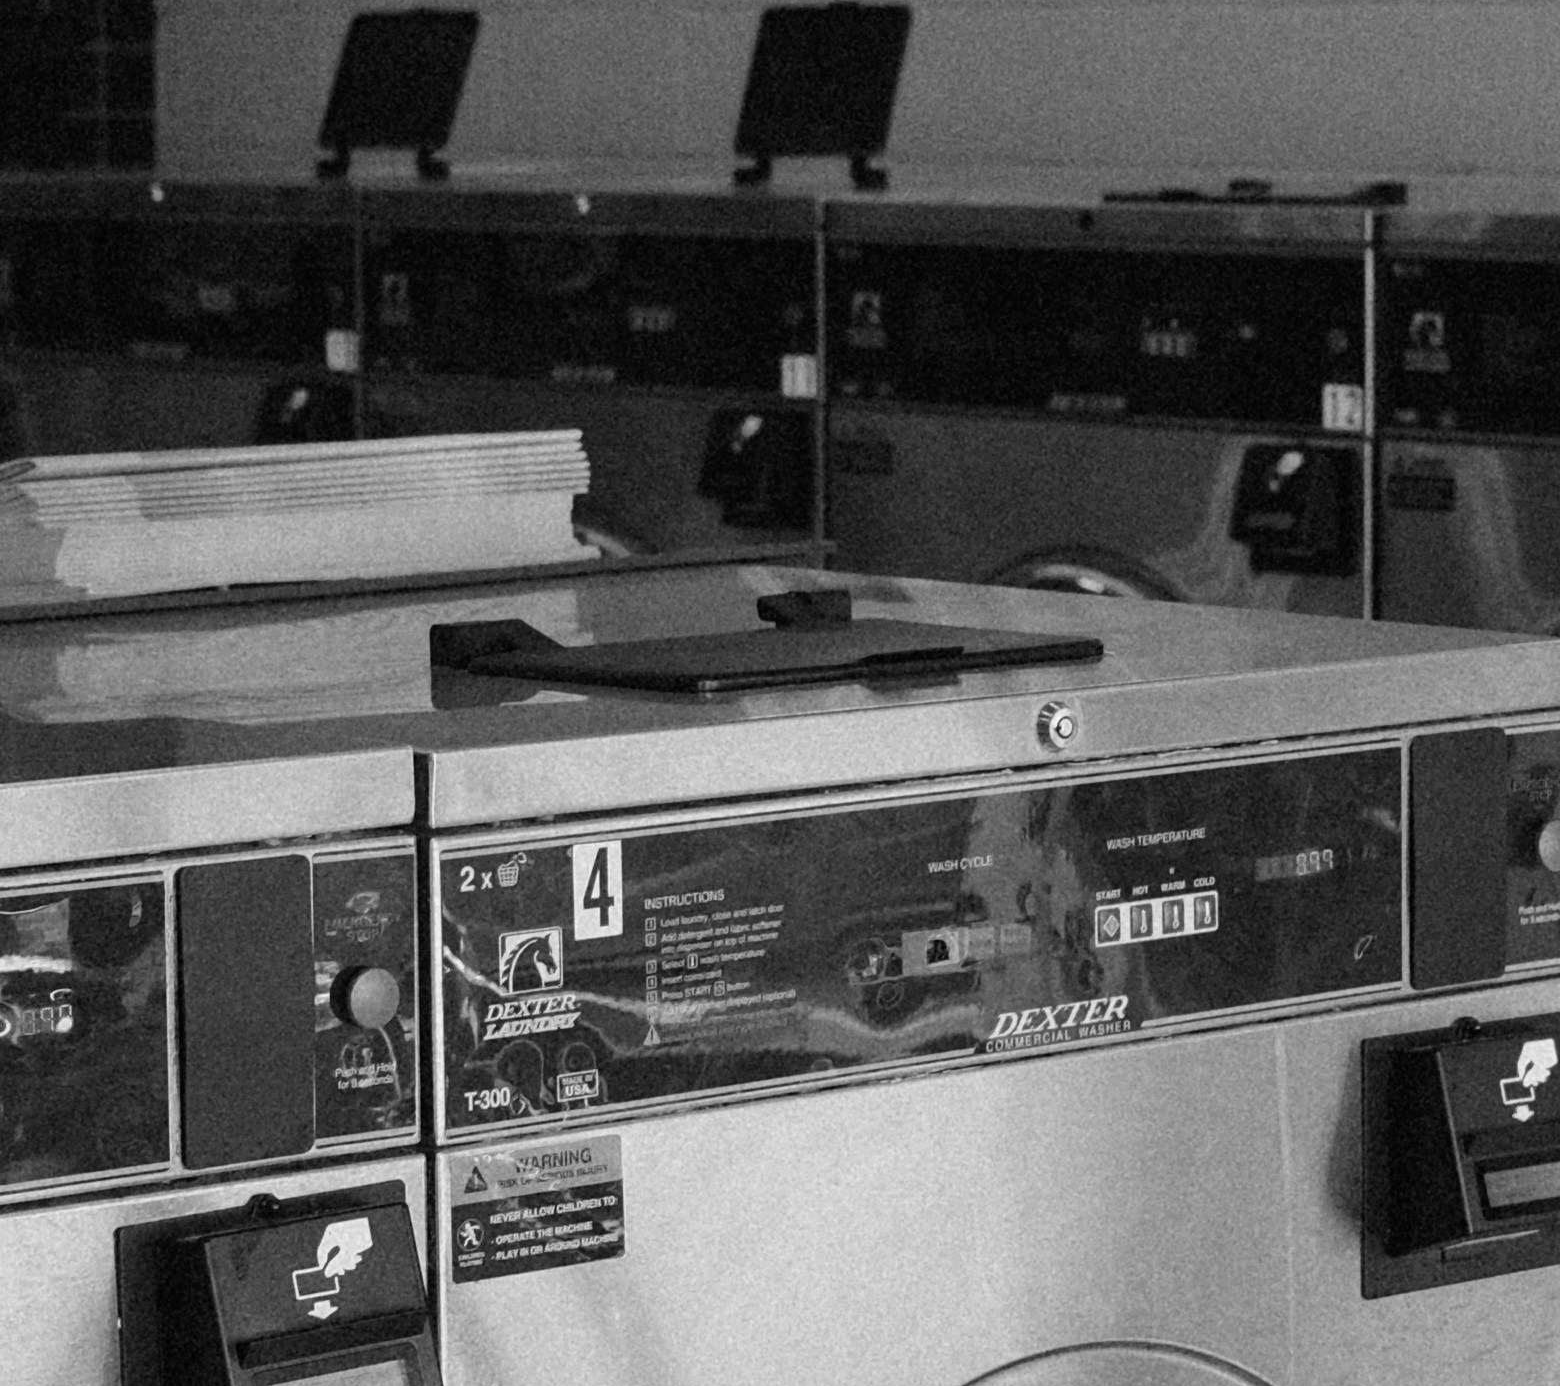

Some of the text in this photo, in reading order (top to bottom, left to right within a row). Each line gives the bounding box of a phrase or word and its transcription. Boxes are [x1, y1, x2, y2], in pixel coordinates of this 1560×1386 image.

[1106, 827, 1207, 851] WASH TEMPERATURE
[928, 854, 994, 874] WASH CYCLE
[460, 865, 494, 893] 2 x
[583, 846, 616, 928] 4
[1095, 876, 1216, 901] START HOT WARM COLD
[644, 888, 725, 910] INSTRUCTIONS
[484, 994, 577, 1023] DEXTER
[989, 994, 1130, 1040] DEXTER
[483, 1011, 582, 1041] LAUNDRY
[985, 1020, 1132, 1053] COMMERCIAL WASHER
[464, 1086, 511, 1112] T-300
[565, 1083, 591, 1097] USA
[515, 1147, 593, 1174] WARNING
